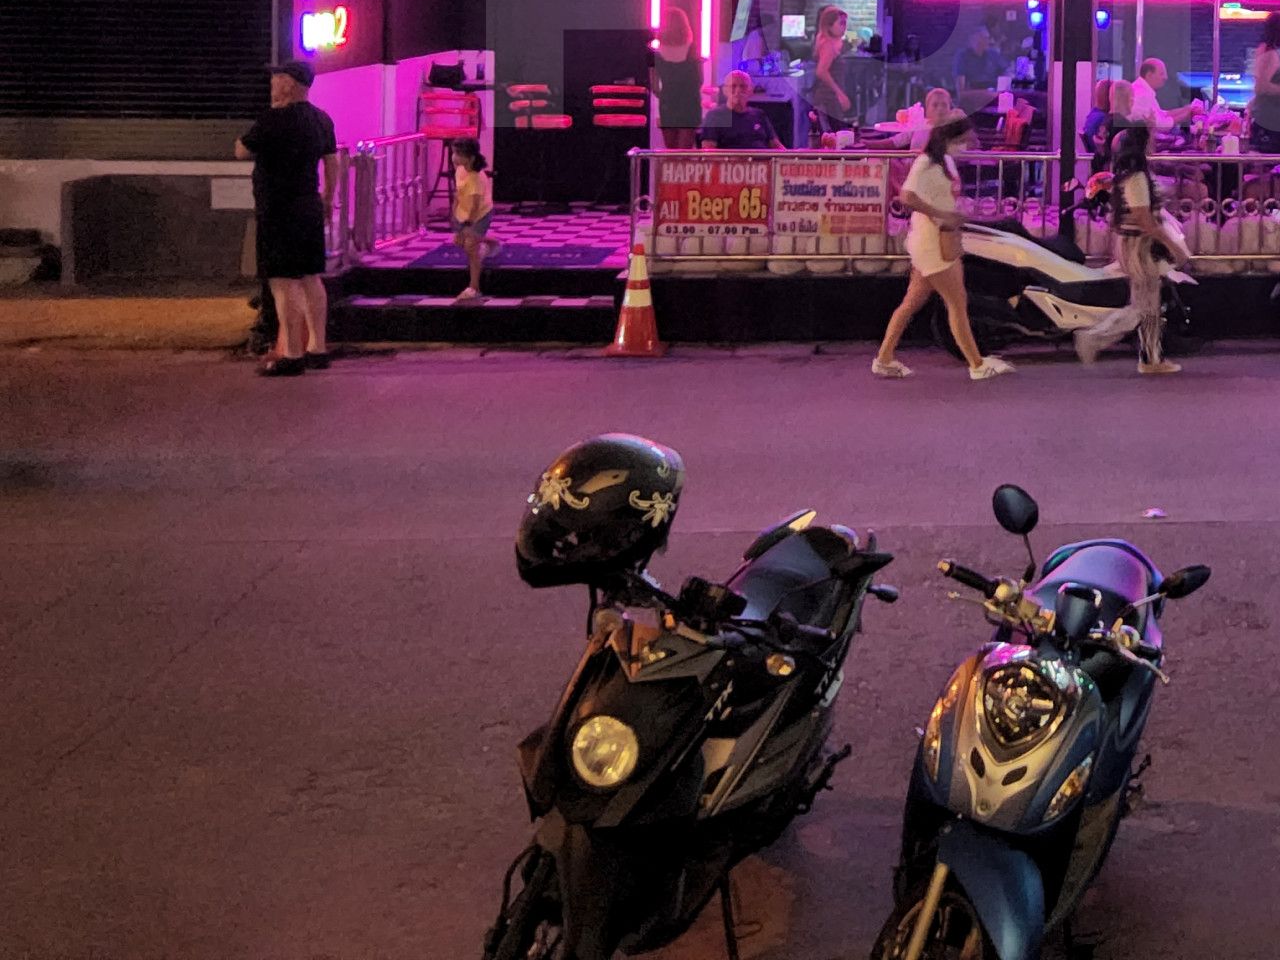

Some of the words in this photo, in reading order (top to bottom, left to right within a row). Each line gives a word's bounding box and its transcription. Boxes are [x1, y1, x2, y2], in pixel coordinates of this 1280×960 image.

[334, 6, 348, 46] 2
[661, 162, 713, 184] HAPPY
[720, 163, 768, 185] HOUR
[660, 199, 680, 220] All
[687, 189, 734, 221] Beer
[707, 225, 738, 235] 07.00
